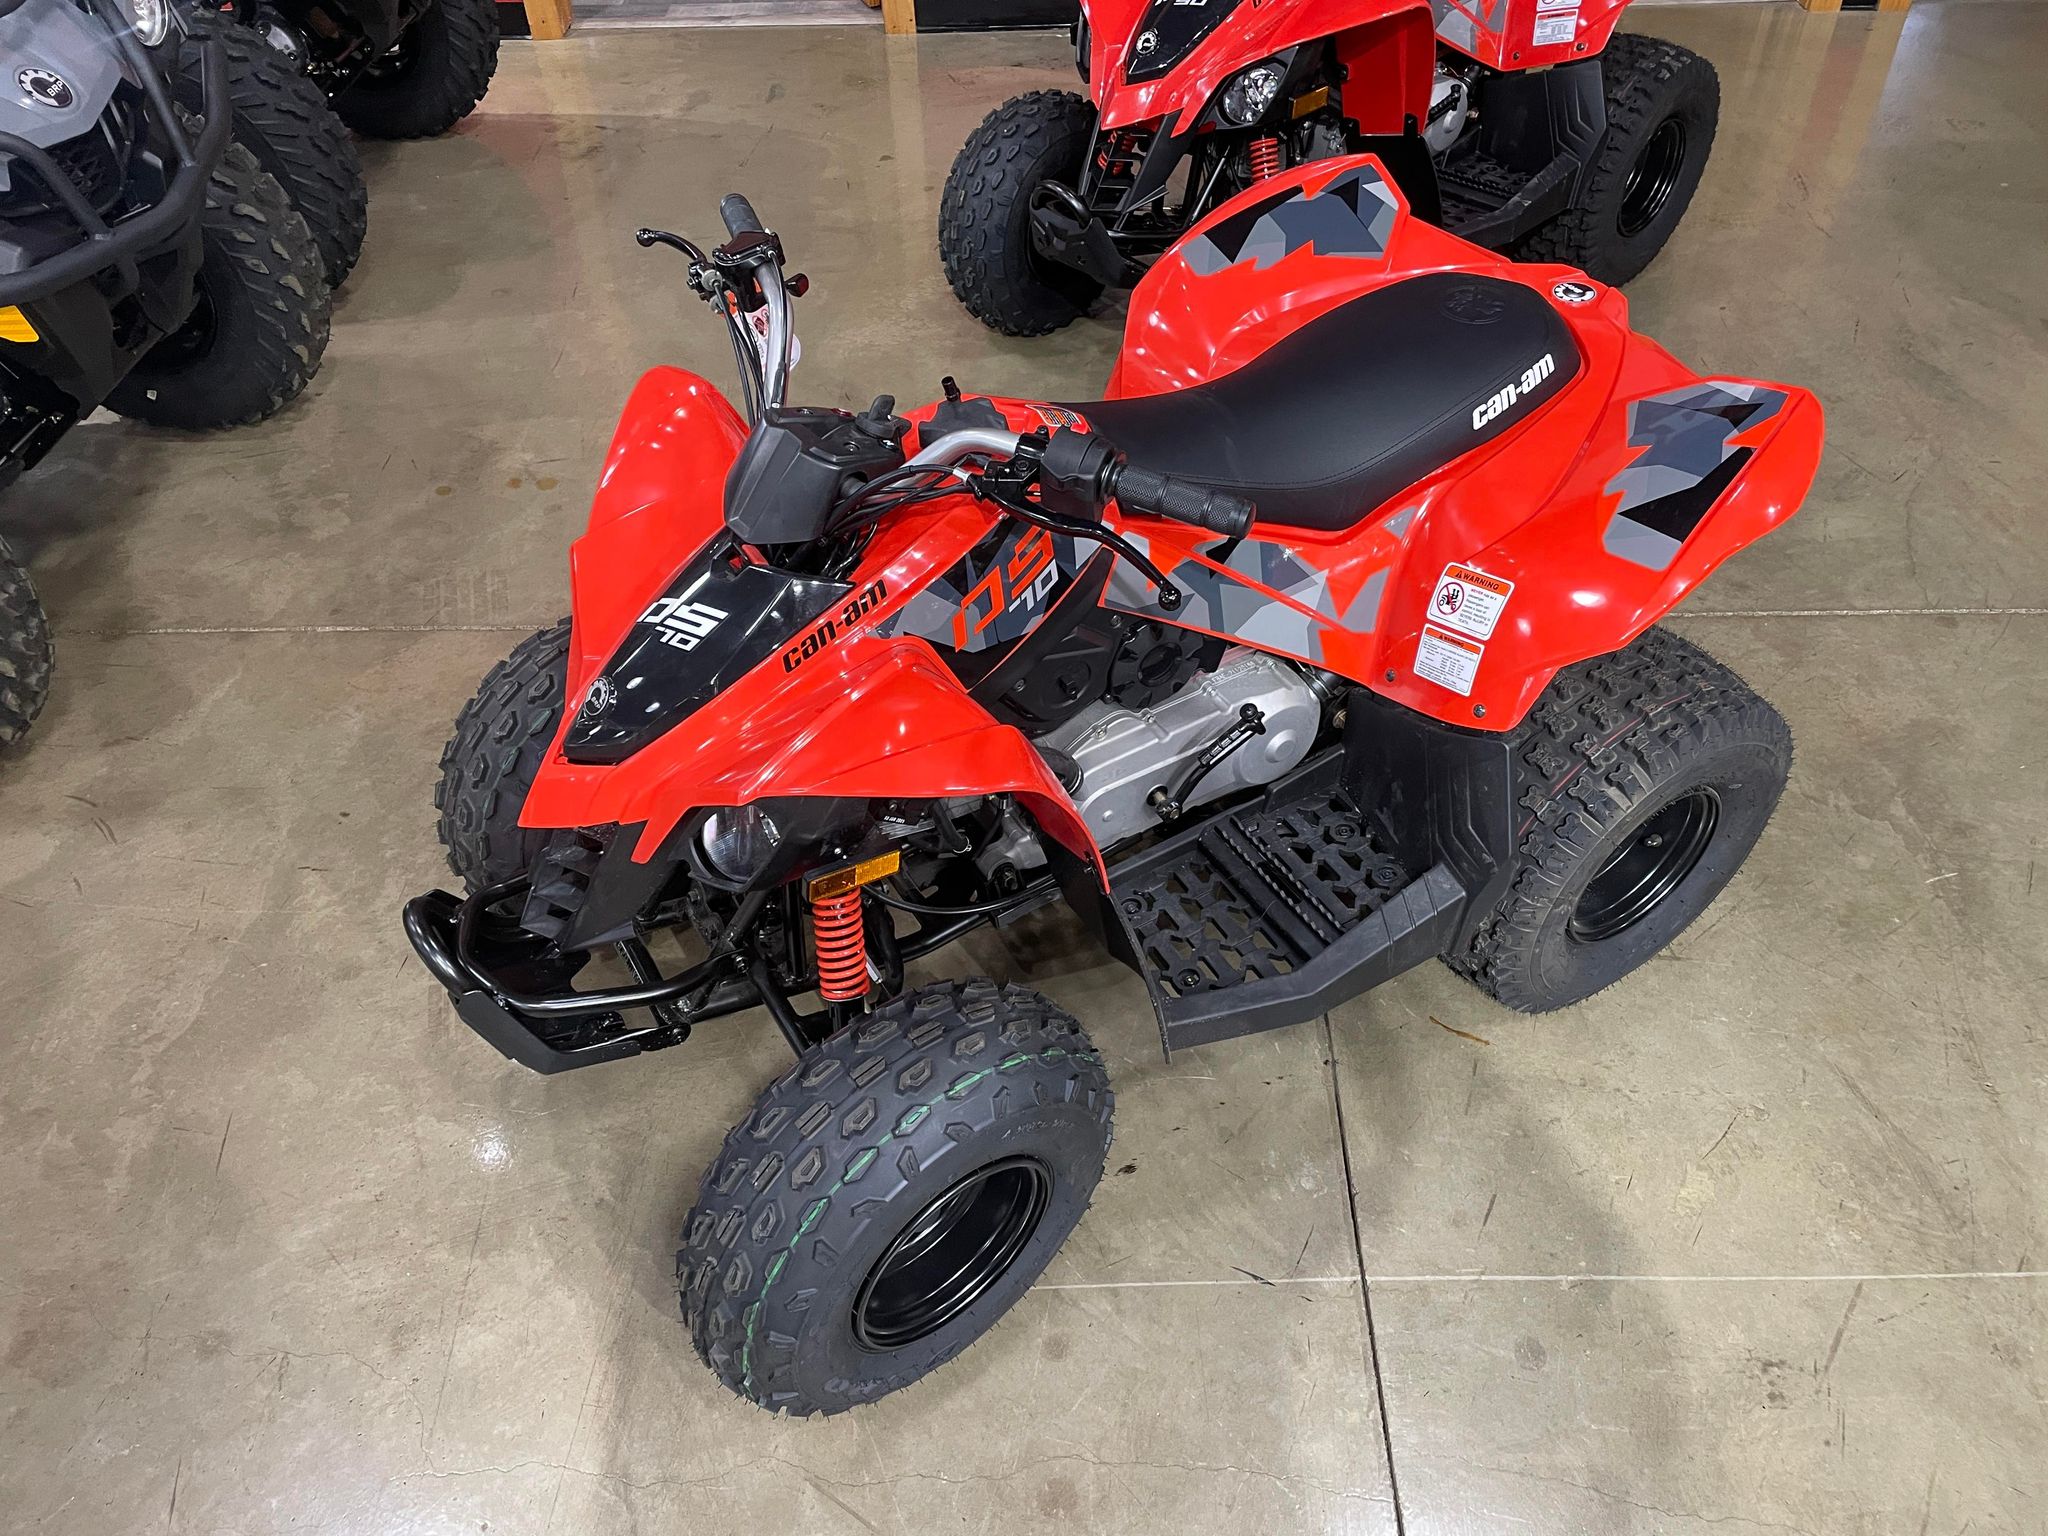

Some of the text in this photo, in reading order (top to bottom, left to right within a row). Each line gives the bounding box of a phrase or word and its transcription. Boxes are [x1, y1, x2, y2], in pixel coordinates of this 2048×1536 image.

[46, 80, 63, 97] BRP
[1472, 353, 1556, 431] can-am
[1008, 558, 1059, 613] 70
[1462, 572, 1500, 591] WARNING
[654, 625, 701, 652] 70
[783, 578, 889, 674] can-am
